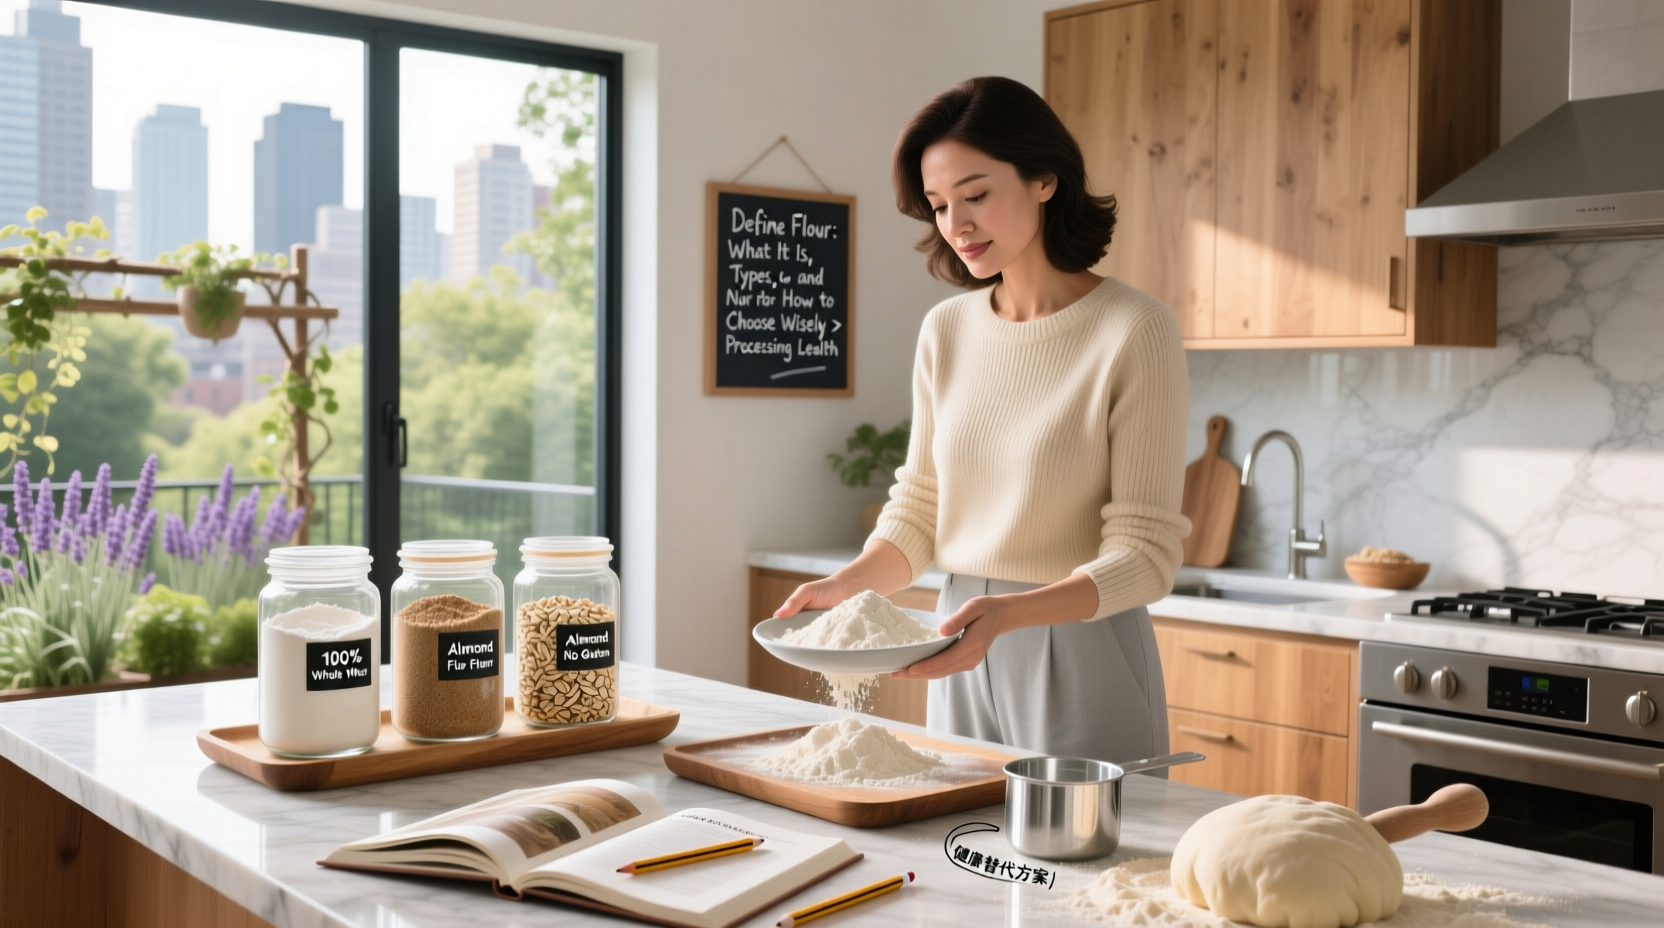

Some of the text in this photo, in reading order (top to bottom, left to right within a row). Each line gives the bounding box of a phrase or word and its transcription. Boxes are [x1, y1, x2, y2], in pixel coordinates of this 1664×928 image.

[732, 207, 837, 239] Define Flour:
[728, 239, 813, 267] What It Is,
[729, 264, 777, 291] Types,
[798, 267, 824, 285] and
[782, 289, 813, 308] How
[819, 291, 835, 308] to
[725, 311, 776, 331] Choose
[780, 313, 826, 341] Wisely
[725, 334, 792, 363] Processing
[321, 647, 363, 666] 100%
[447, 639, 493, 656] Almond
[563, 648, 579, 661] No
